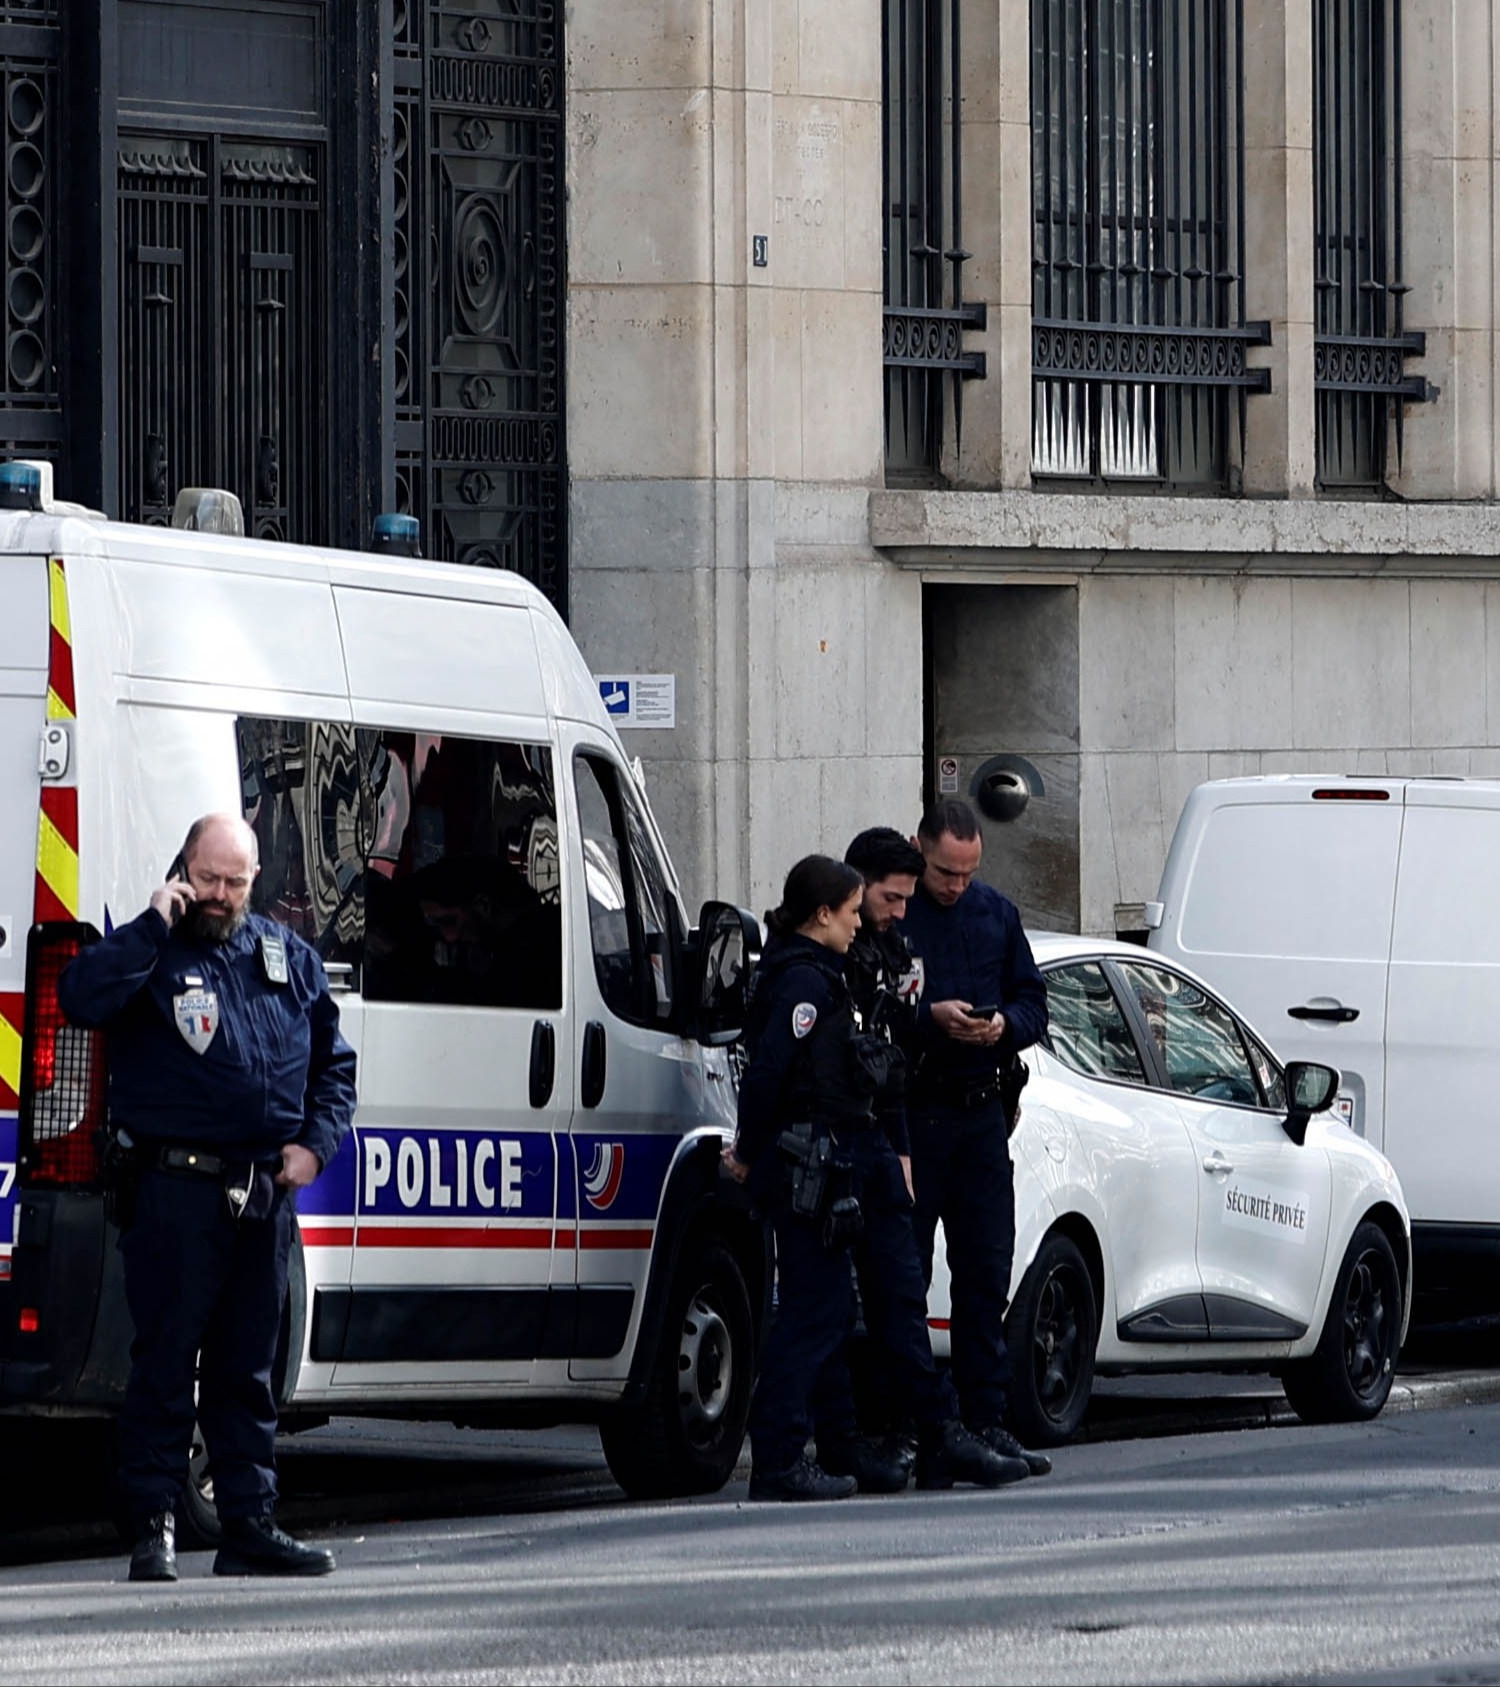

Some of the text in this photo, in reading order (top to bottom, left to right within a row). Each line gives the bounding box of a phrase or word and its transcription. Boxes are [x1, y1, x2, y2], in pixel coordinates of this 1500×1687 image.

[755, 239, 767, 261] 51
[363, 1136, 523, 1208] POLICE
[1226, 1185, 1306, 1230] SÉCURITÉ PRIVÉE
